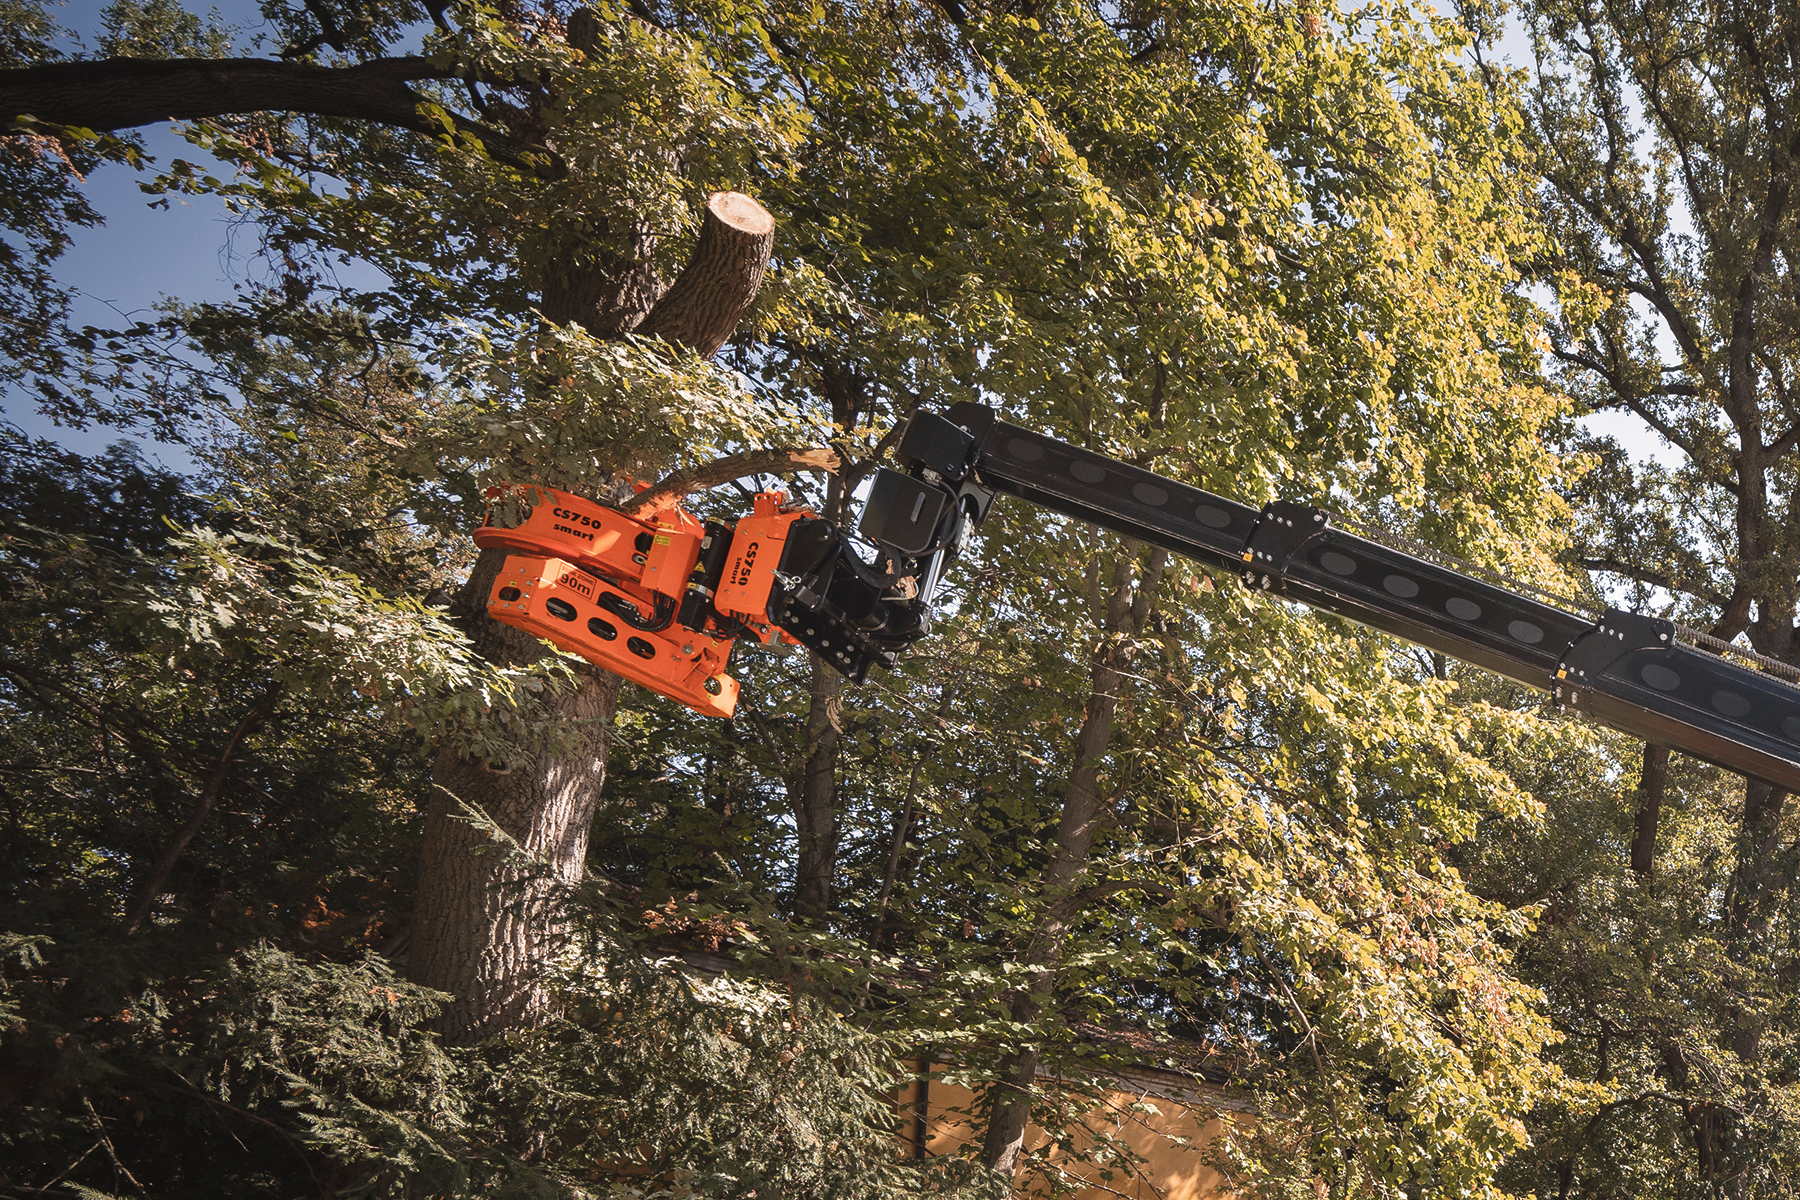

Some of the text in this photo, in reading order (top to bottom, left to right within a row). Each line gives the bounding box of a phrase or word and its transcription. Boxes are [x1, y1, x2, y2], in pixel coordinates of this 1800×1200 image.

[553, 507, 602, 530] CS750
[553, 523, 595, 541] smart
[738, 542, 759, 586] CS750
[560, 573, 591, 595] 90m
